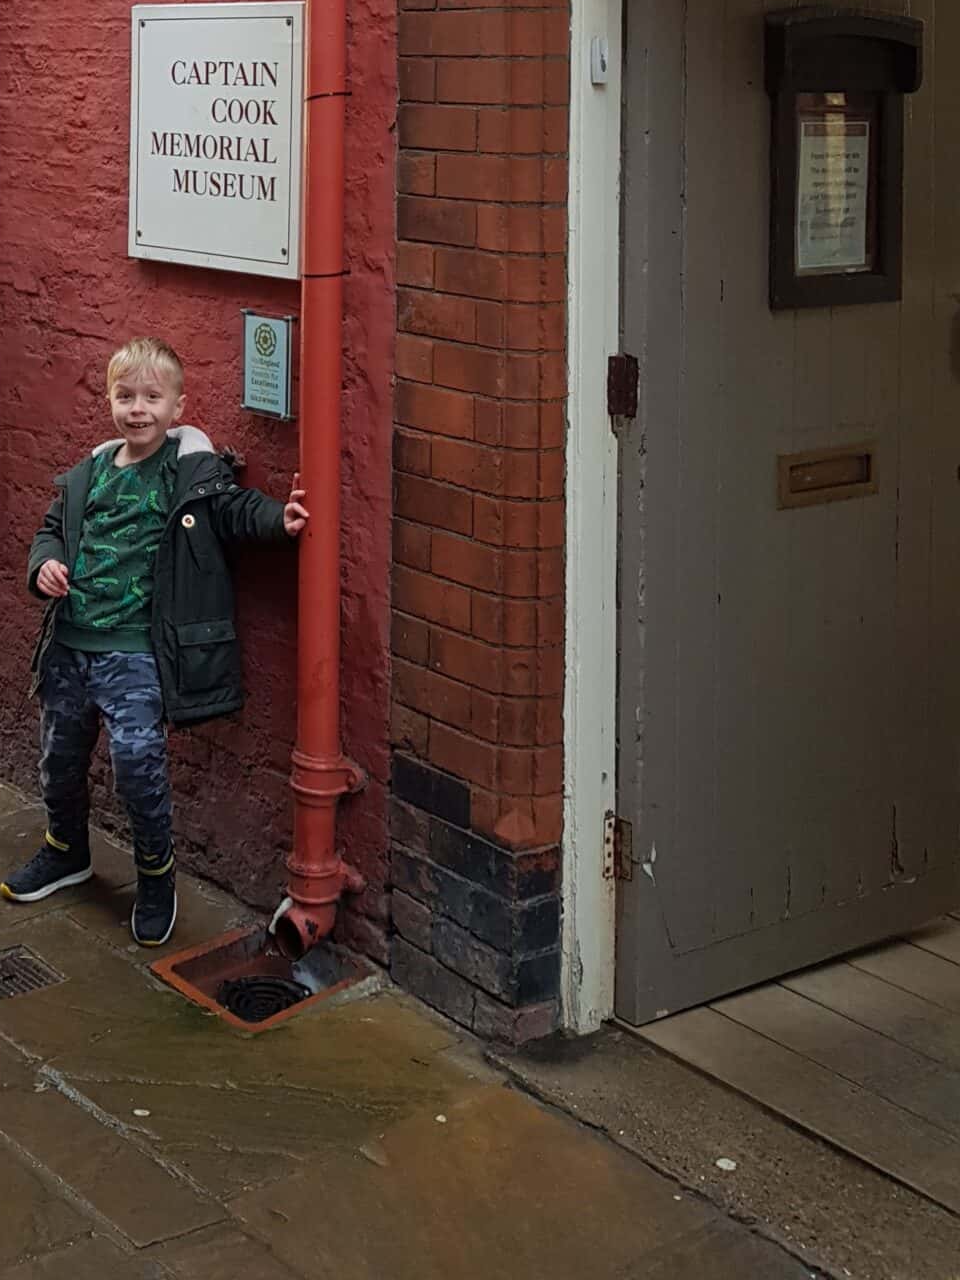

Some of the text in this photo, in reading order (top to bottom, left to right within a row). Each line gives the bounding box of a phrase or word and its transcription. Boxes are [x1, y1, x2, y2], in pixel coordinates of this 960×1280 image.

[171, 60, 279, 87] CAPTAIN
[211, 98, 277, 125] COOK
[151, 132, 277, 164] MEMORIAL
[172, 168, 276, 201] MUSEUM
